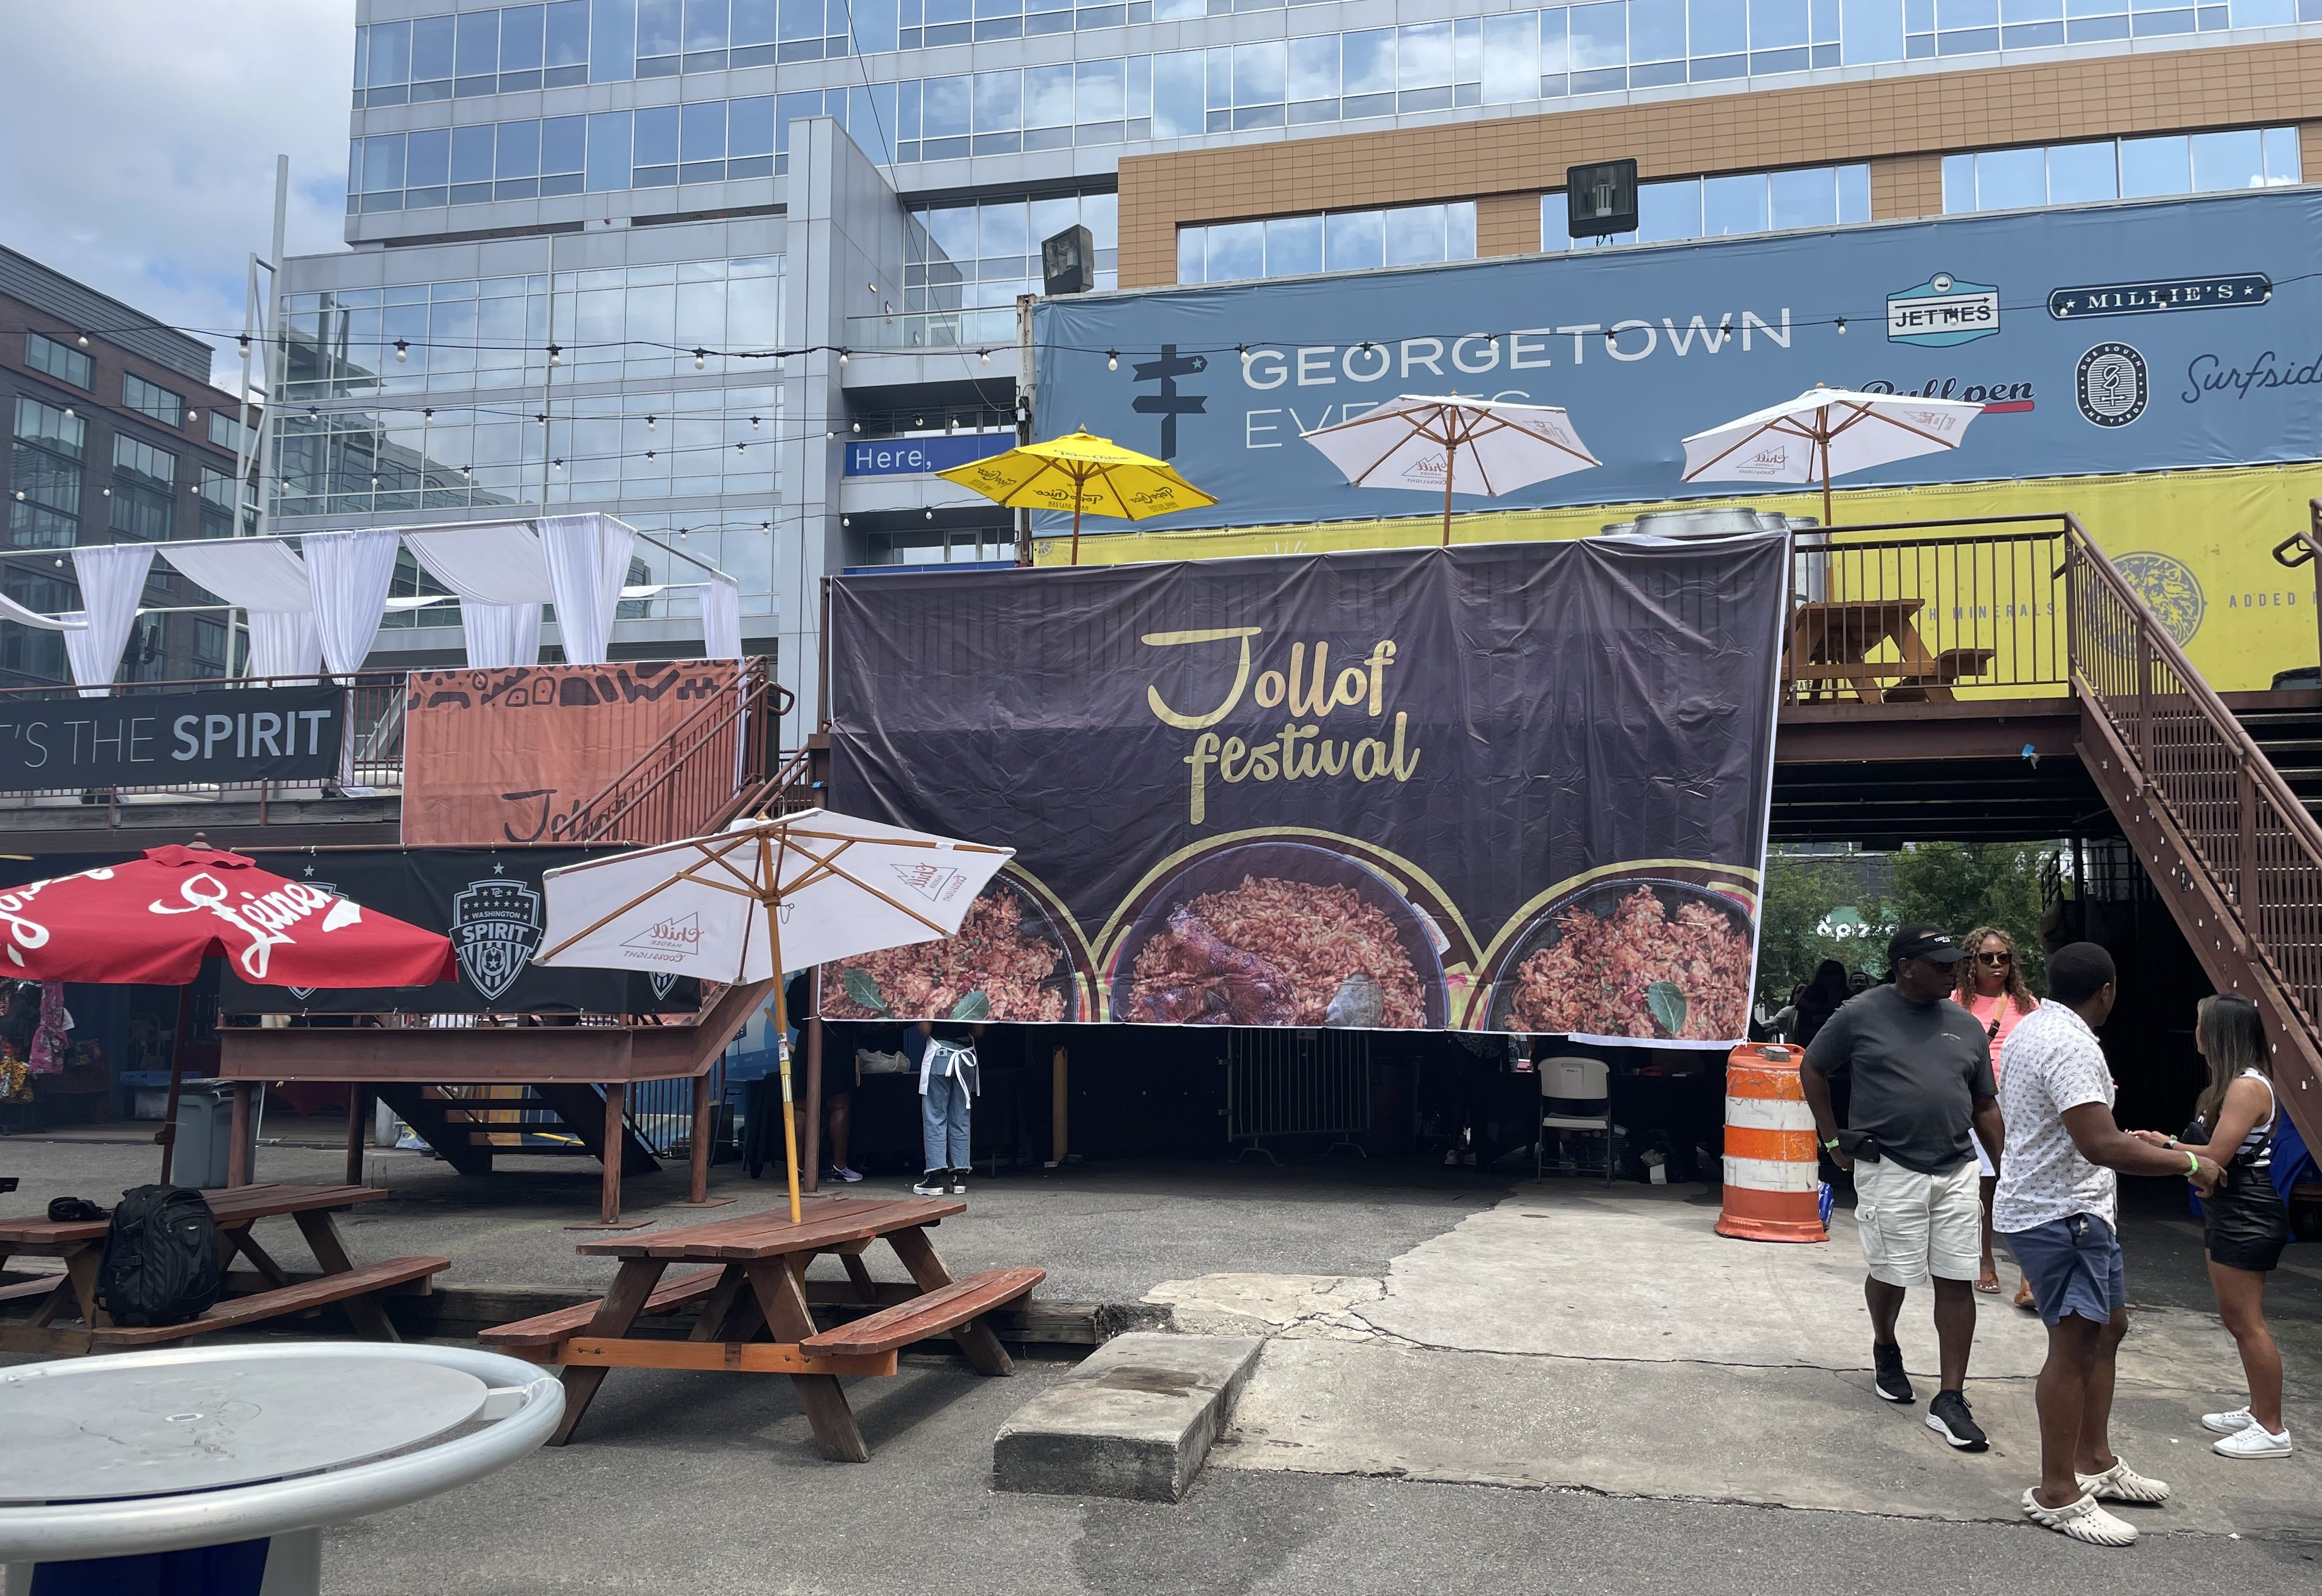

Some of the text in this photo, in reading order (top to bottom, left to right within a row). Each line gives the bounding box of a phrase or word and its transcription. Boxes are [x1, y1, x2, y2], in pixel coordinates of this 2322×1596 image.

[2087, 284, 2233, 309] MILLIE'S
[1242, 307, 1791, 390] GEORGETOWN
[2080, 346, 2142, 370] DUE SOUTH
[2181, 351, 2322, 404] Surfsid
[2083, 401, 2143, 424] THE YARDS
[856, 448, 931, 470] Here,
[1953, 602, 2054, 620] MINERALS
[2229, 592, 2296, 608] ADDED
[1141, 626, 1397, 730] Jollof
[63, 717, 155, 765] THE
[171, 710, 331, 761] SPIRIT
[1183, 711, 1421, 825] festival
[501, 789, 627, 842] Jollof
[472, 910, 521, 919] WASHINGTON
[462, 923, 529, 943] SPIRIT
